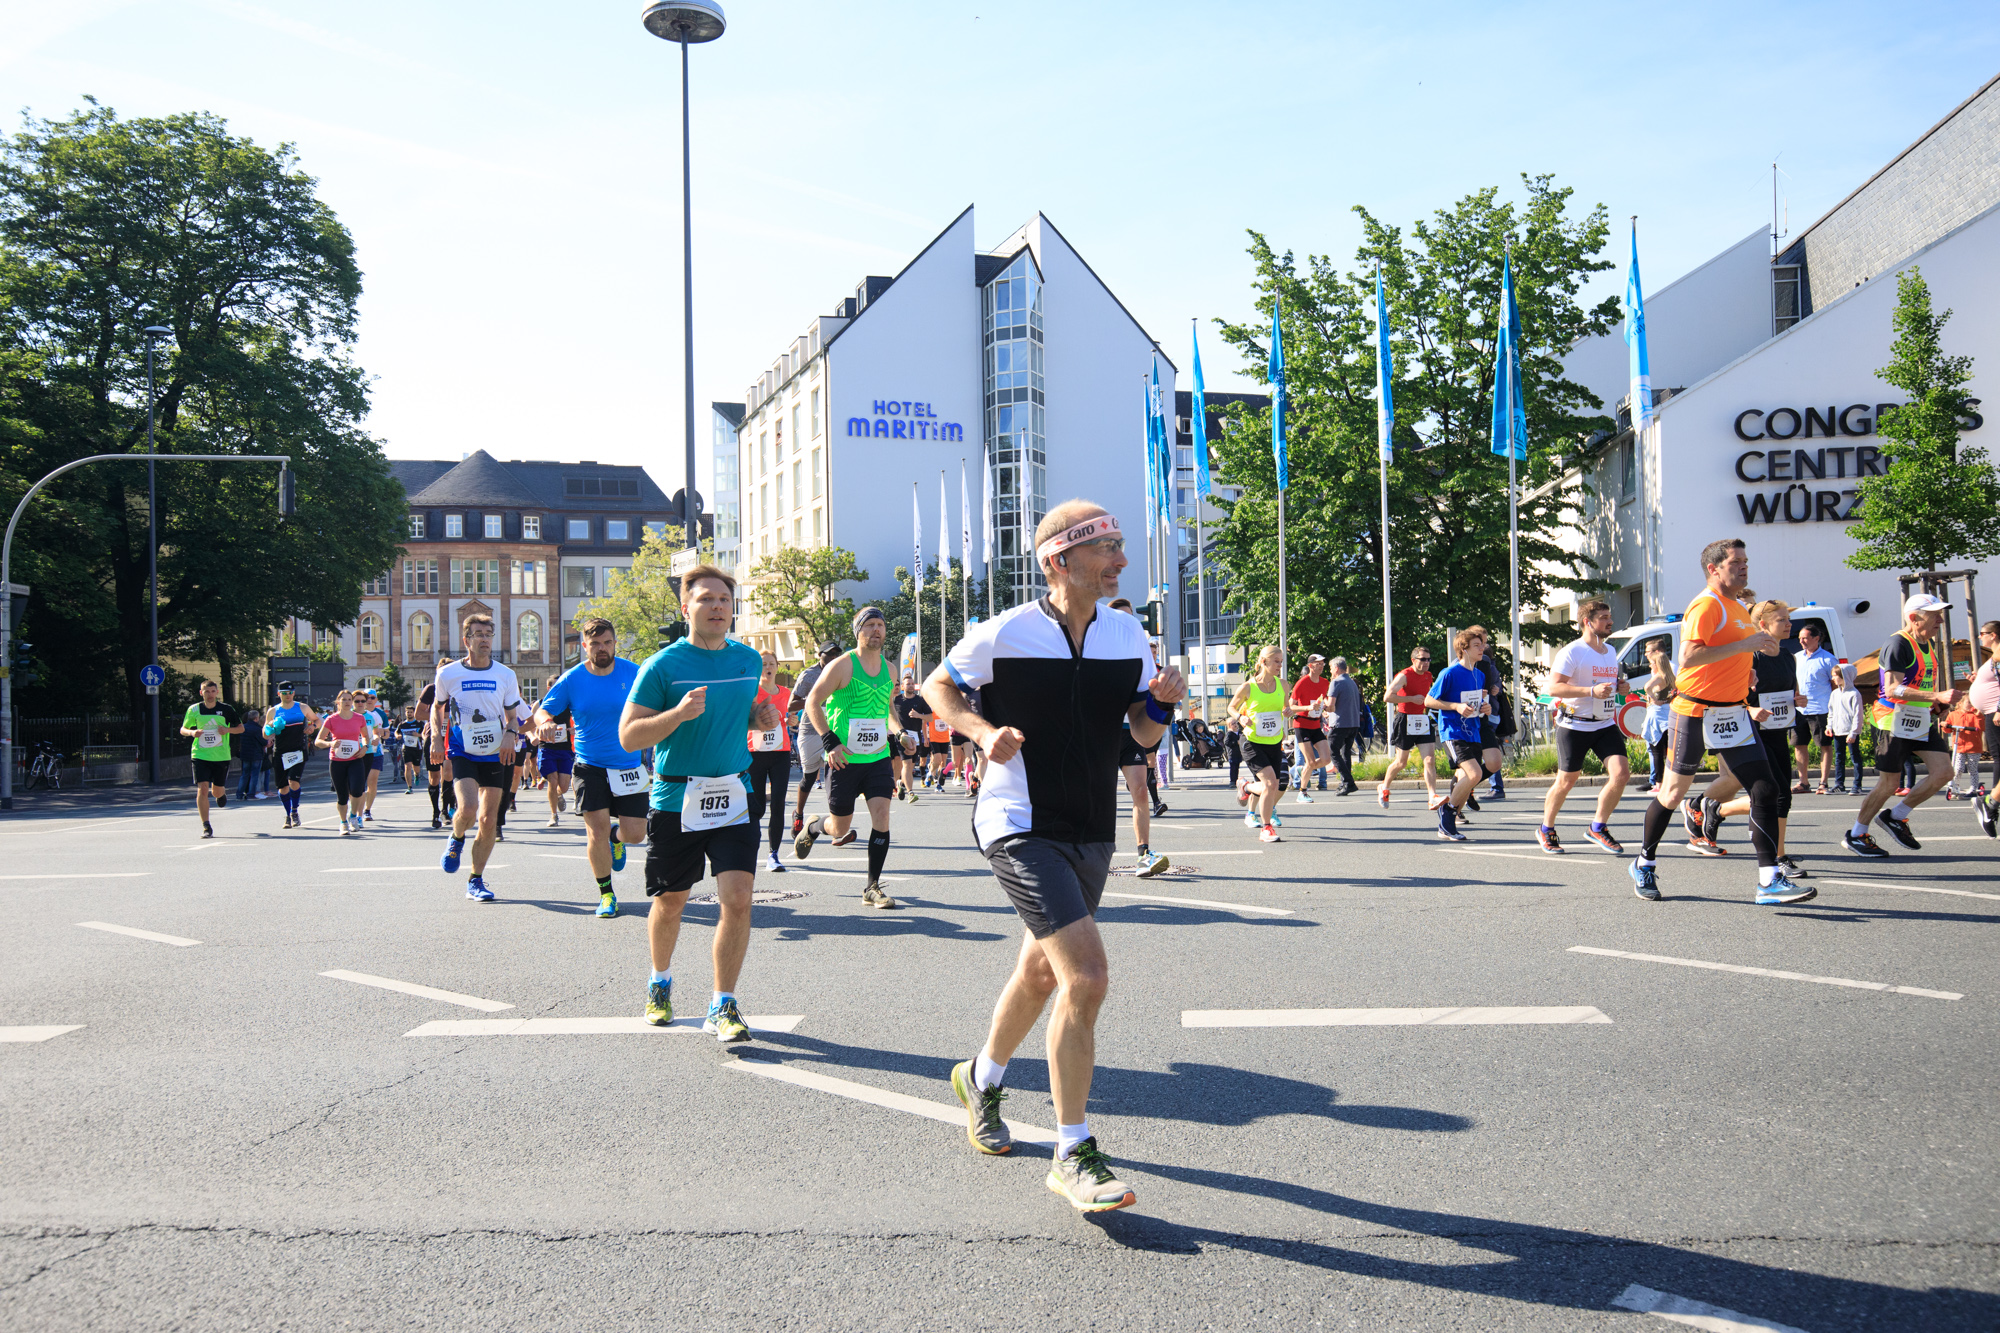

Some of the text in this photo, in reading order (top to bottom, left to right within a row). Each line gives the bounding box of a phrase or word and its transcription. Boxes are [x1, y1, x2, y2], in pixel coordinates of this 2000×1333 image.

[873, 399, 938, 418] HOTEL
[1734, 398, 1984, 441] CONGS
[847, 417, 963, 442] MARITIM
[1067, 524, 1095, 542] Caro
[1771, 705, 1788, 717] 1018
[1262, 721, 1276, 729] 2515
[1713, 721, 1739, 734] 2343
[1901, 718, 1921, 729] 1190
[472, 734, 495, 745] 2535
[763, 733, 775, 742] 812
[857, 732, 879, 742] 2558
[620, 771, 640, 783] 1704
[700, 795, 730, 810] 1973
[702, 811, 727, 819] Christian
